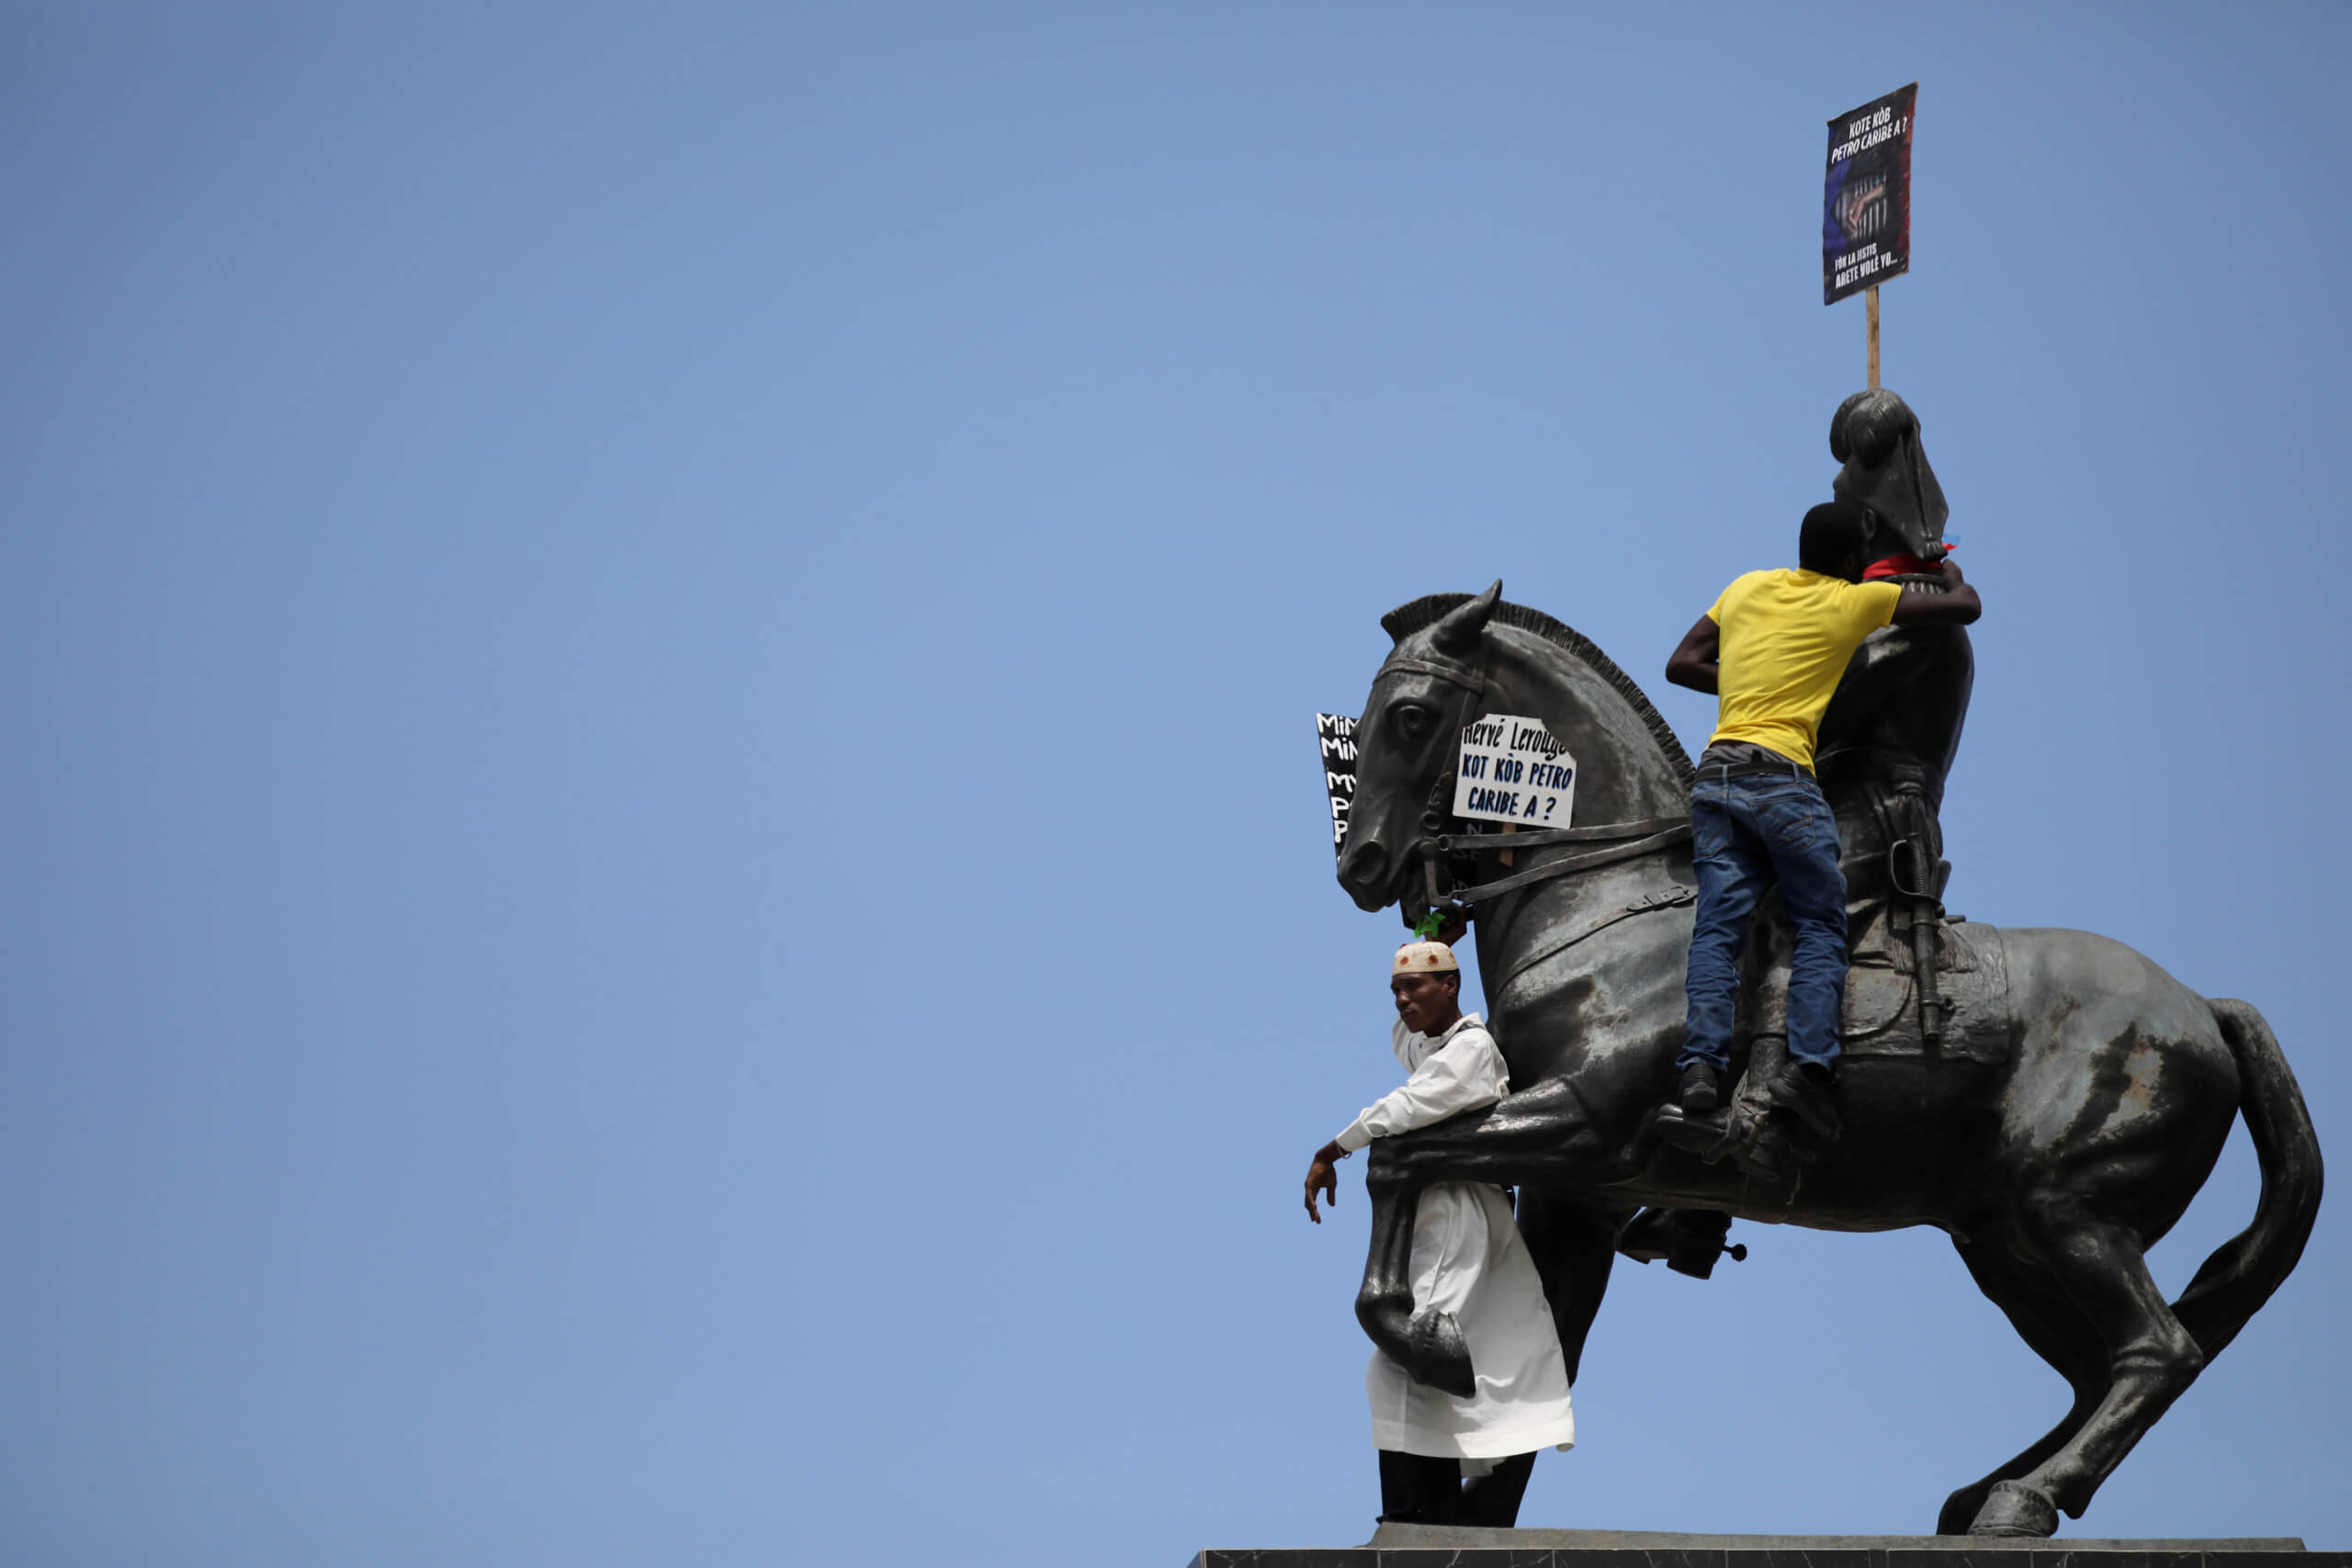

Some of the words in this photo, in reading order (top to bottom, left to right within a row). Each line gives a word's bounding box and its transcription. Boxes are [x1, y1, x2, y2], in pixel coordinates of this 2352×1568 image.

[1831, 139, 1860, 164] PETRO
[1860, 122, 1894, 151] CARIBE
[1894, 119, 1901, 136] A
[1902, 116, 1908, 133] ?
[1849, 115, 1871, 139] KOTE
[1848, 252, 1857, 265] LA
[1836, 265, 1859, 289] ARETE
[1462, 753, 1489, 780] KOT
[1529, 762, 1573, 791] PETRO
[1468, 786, 1520, 816] CARIBE
[1523, 795, 1538, 818] A
[1544, 796, 1557, 820] ?
